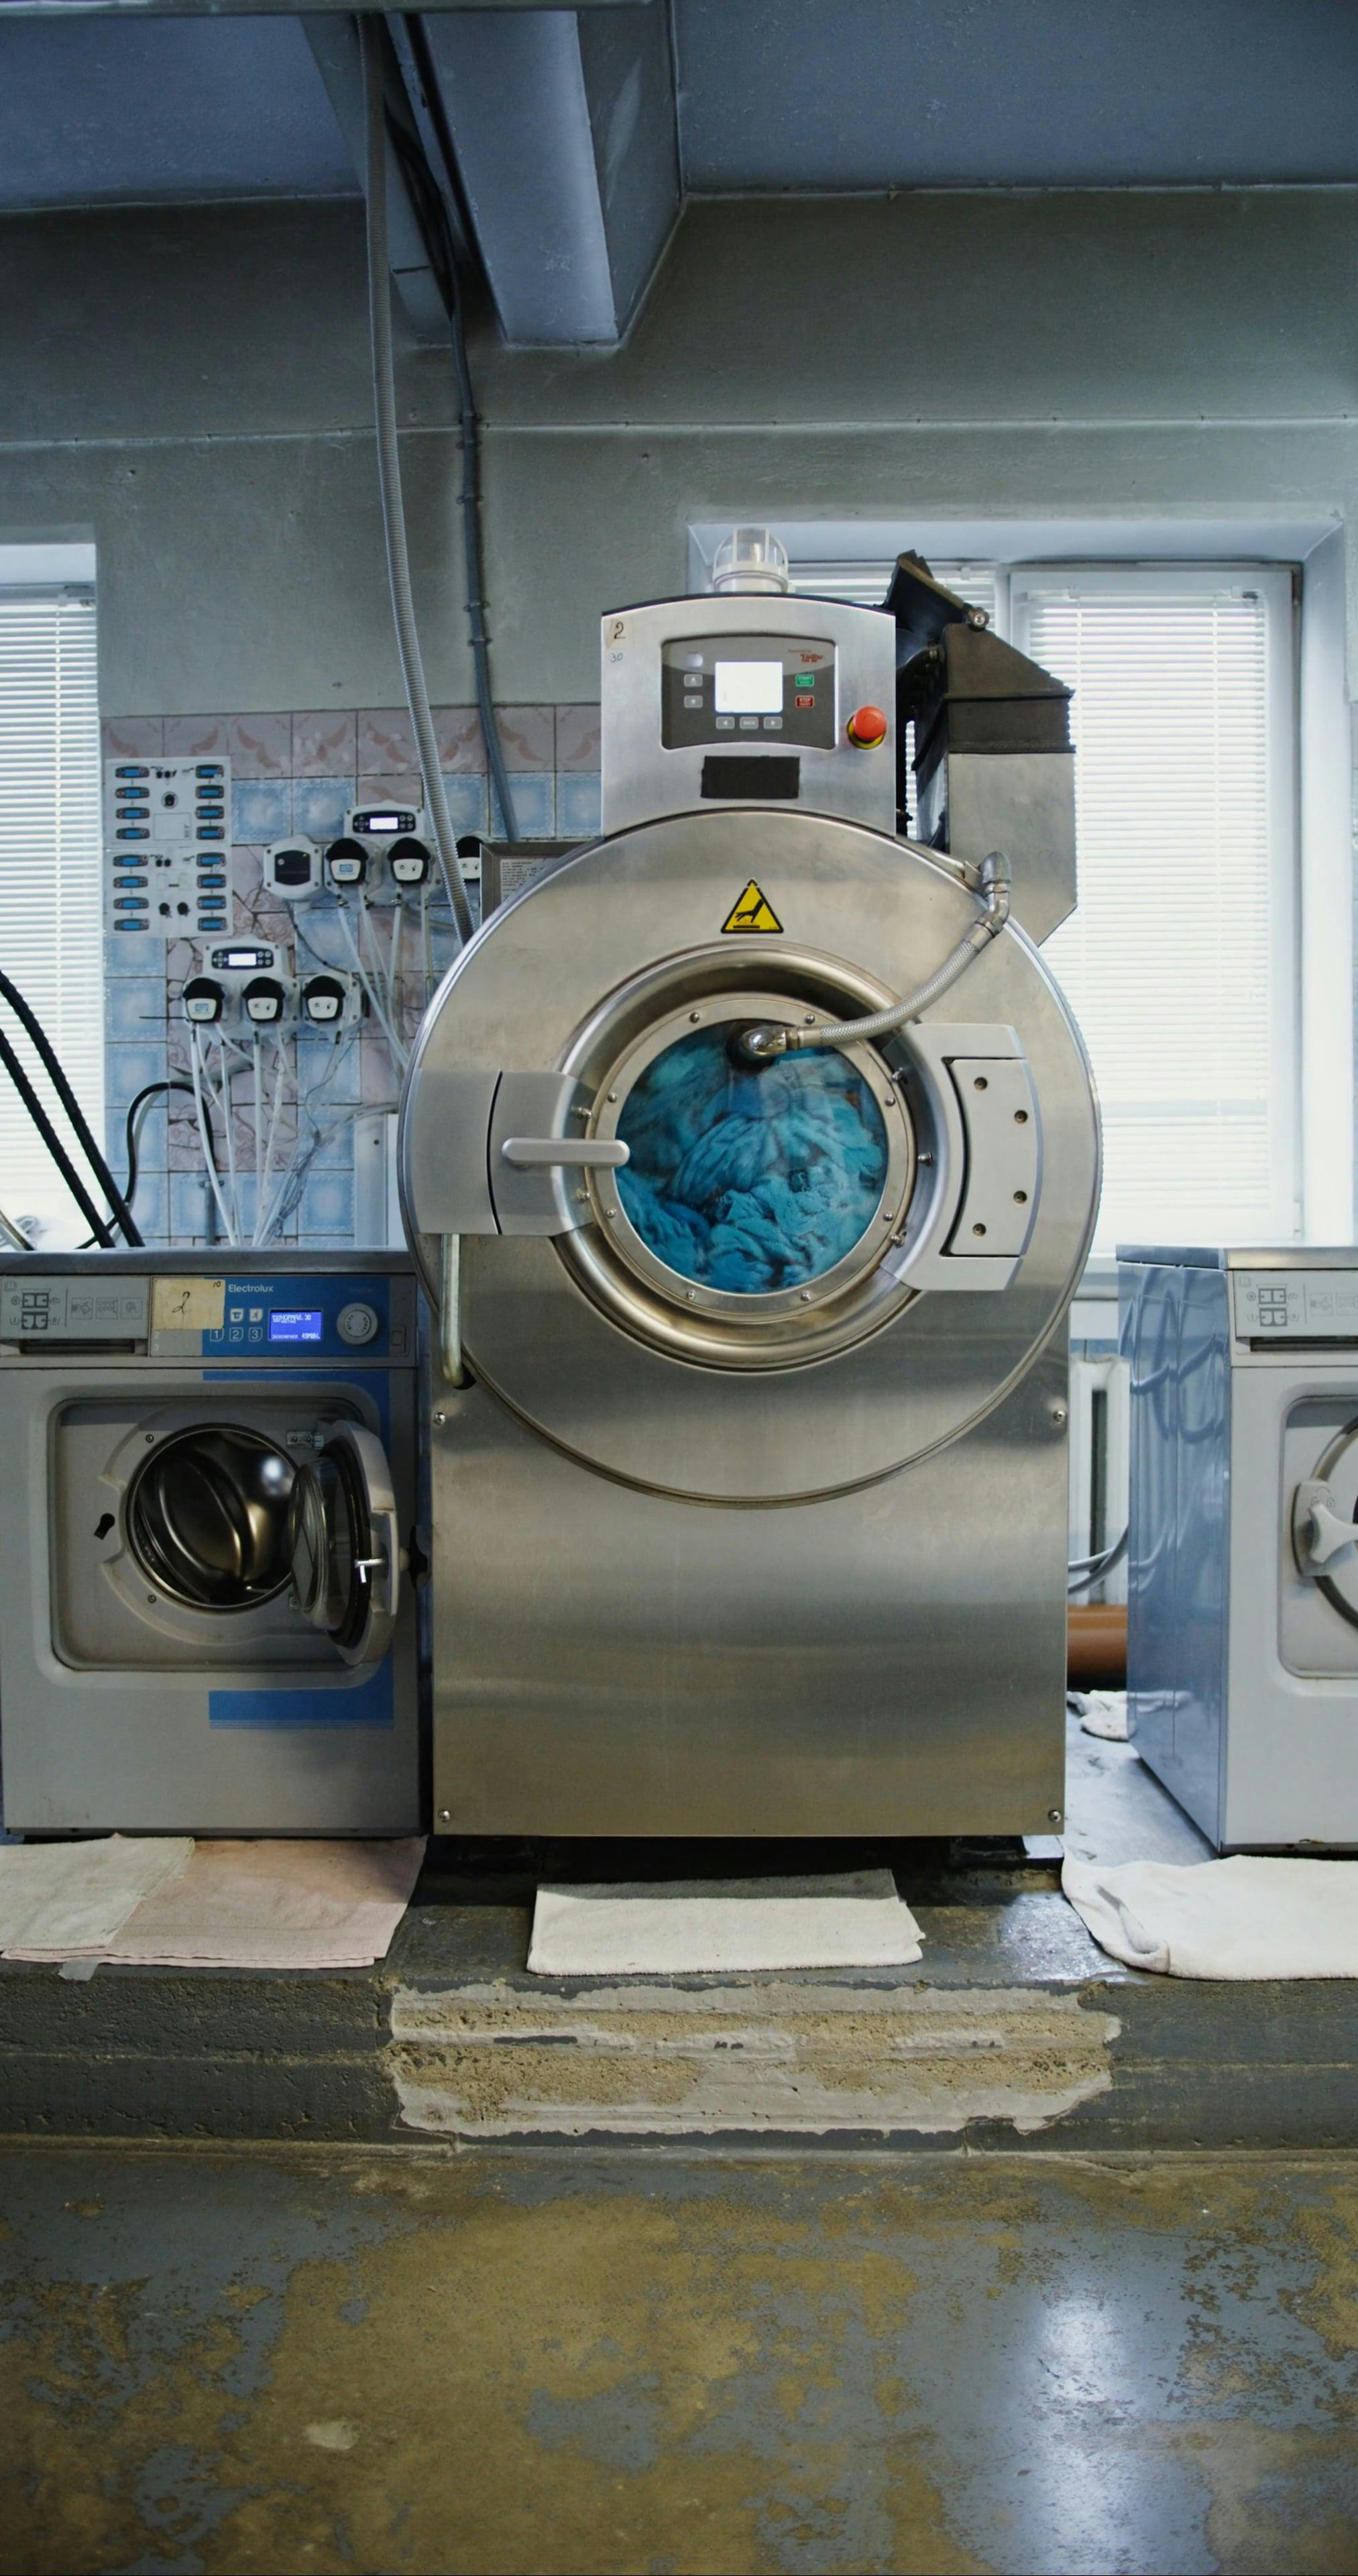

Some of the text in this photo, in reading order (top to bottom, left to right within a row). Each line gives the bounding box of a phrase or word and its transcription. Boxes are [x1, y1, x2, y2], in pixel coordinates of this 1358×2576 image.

[614, 621, 626, 639] 2
[610, 653, 624, 663] 30
[228, 1283, 274, 1293] Electrolux
[172, 1291, 191, 1314] 2
[214, 1330, 259, 1340] 1 2 3
